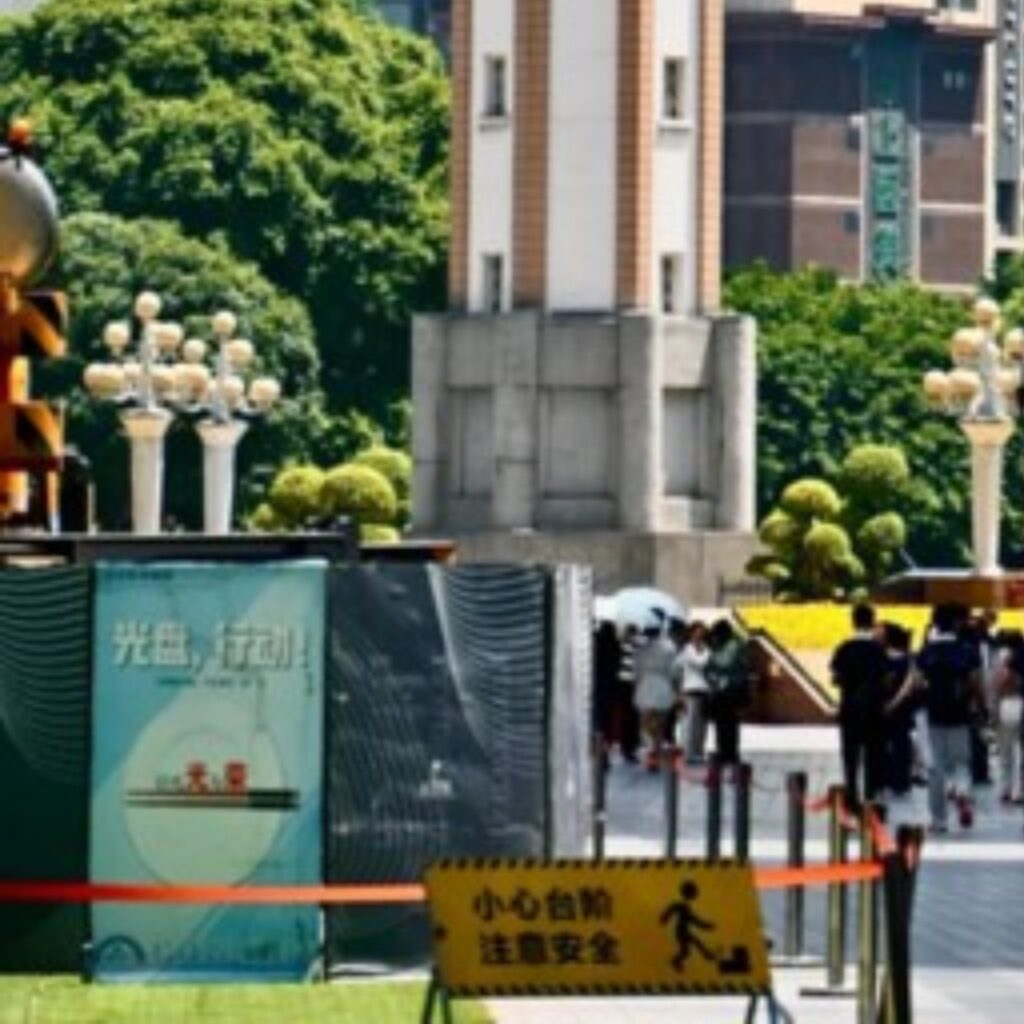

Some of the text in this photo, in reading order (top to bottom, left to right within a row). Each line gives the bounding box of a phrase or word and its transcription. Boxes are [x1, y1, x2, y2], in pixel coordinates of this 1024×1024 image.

[472, 887, 615, 921] 小心台阶
[479, 930, 623, 965] 注意安全
